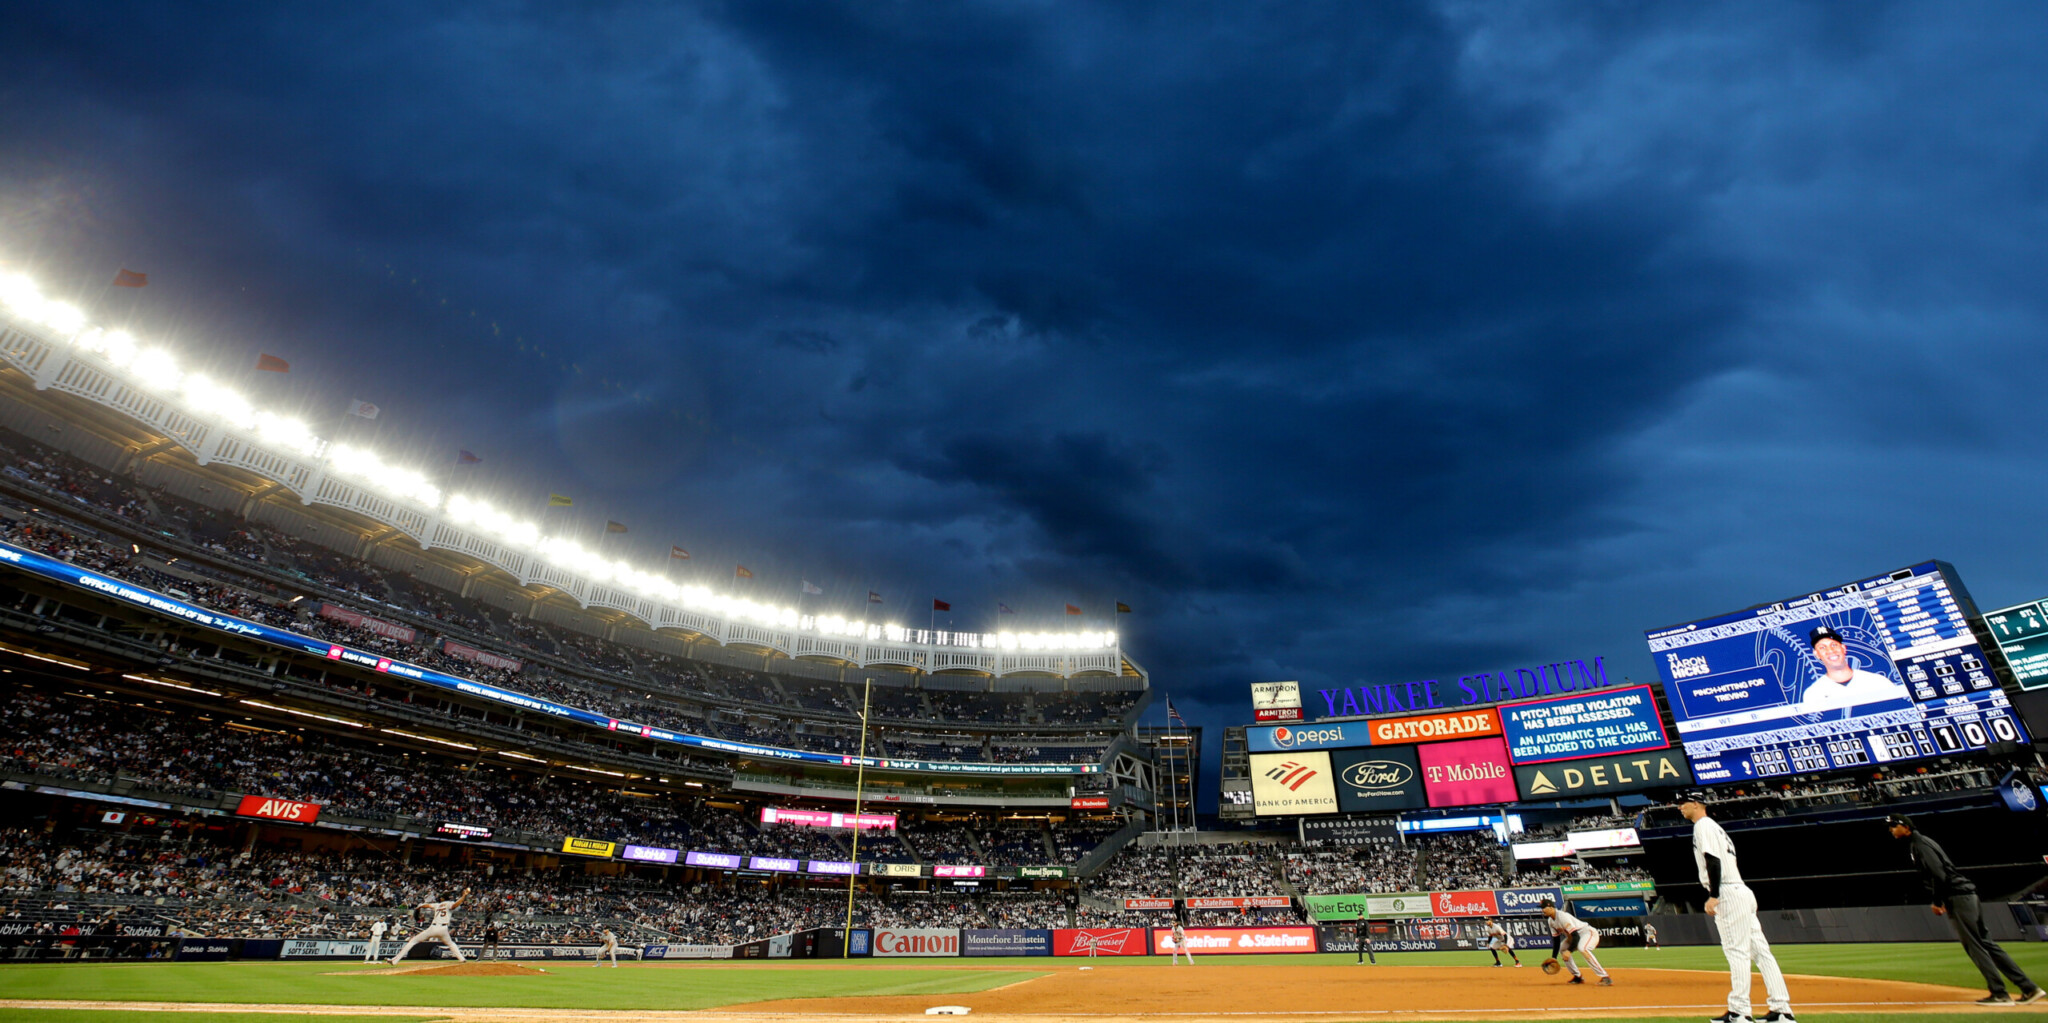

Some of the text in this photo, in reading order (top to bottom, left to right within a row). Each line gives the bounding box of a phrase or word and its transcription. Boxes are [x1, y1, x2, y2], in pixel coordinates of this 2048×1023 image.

[79, 575, 120, 594] OFFICIAL
[118, 587, 151, 604] HYBRID
[149, 595, 186, 616] VEHICLES
[2019, 608, 2036, 618] STL
[1989, 615, 2008, 625] TOR
[360, 617, 410, 640] PARTY DECK
[2000, 623, 2010, 635] 1
[1666, 653, 1679, 663] 31
[1670, 656, 1706, 670] AARON
[1672, 665, 1710, 679] HICKS
[1254, 684, 1297, 693] ARMITRON
[1318, 656, 1611, 717] YANKEE STADIUM
[1693, 678, 1766, 697] PINCH-HITTING FOR
[1715, 691, 1749, 702] TREVINO
[1259, 709, 1298, 717] ARMITRON
[1511, 695, 1641, 721] A PITCH TIMER VIOLATION
[1523, 707, 1635, 730] HAS BEEN ASSESSED.
[1929, 718, 1949, 726] BALLS
[1953, 713, 1980, 723] STRIKES
[1377, 714, 1491, 740] GATORADE
[1296, 726, 1343, 746] pepsi
[1519, 721, 1649, 746] AN AUTOMATIC BALL HAS
[1939, 719, 2015, 749] 1 0 0
[1513, 731, 1661, 757] BEEN ADDED TO THE COUNT.
[1695, 761, 1722, 771] GIANTS
[1355, 765, 1400, 785] Ford
[1446, 762, 1506, 782] Mobile
[1563, 757, 1680, 789] DELTA
[1697, 770, 1731, 780] YANKEES
[1082, 800, 1108, 808] Budweiser
[1257, 798, 1334, 808] BANK OF AMERICA
[256, 800, 303, 819] AVIS
[633, 847, 667, 861] StubHub
[696, 853, 730, 866] StubHub
[757, 859, 791, 870] StubHub
[816, 863, 851, 873] StubHub
[894, 865, 915, 873] ORIS
[1021, 867, 1063, 878] Poland Spring
[436, 908, 446, 917] 75
[1337, 902, 1365, 913] Eats
[123, 926, 161, 937] StubHub
[875, 931, 958, 953] Canon
[967, 934, 1046, 944] Montefiore Einstein
[1529, 938, 1551, 946] CLEAR
[649, 946, 663, 955] ACC
[1400, 941, 1437, 950] StubHub
[527, 949, 545, 957] COOL
